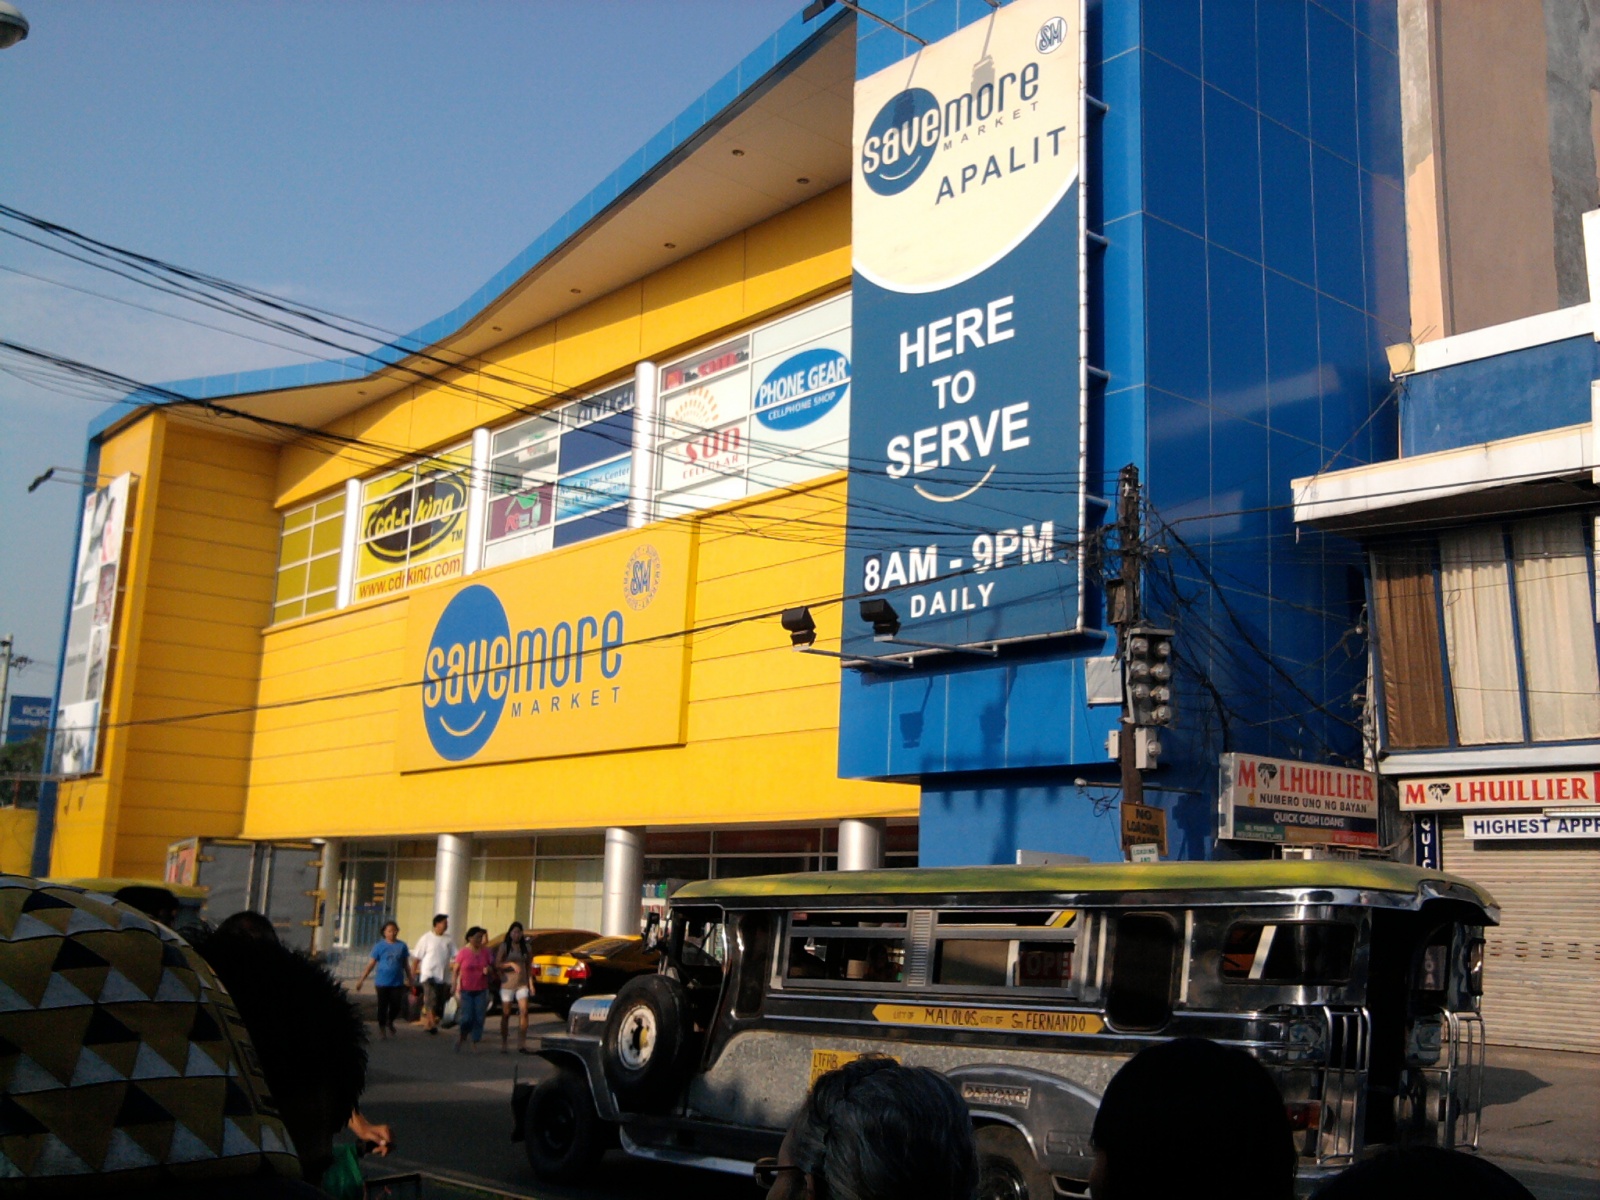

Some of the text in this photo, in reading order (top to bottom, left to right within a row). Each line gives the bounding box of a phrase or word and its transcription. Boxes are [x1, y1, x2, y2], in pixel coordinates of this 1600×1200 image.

[1038, 18, 1063, 53] SM
[862, 62, 1040, 174] savemore
[943, 101, 1039, 152] MARKET
[934, 126, 1067, 206] APALIT
[899, 295, 1015, 374] HERE
[759, 369, 805, 407] PHONE
[807, 356, 847, 390] GEAR
[931, 369, 976, 410] TO
[767, 391, 836, 421] CELLPHONE SHOP
[885, 401, 1030, 479] SERVE
[863, 543, 938, 592] 8AM
[971, 520, 1055, 575] 9PM
[910, 581, 996, 619] DAILY
[424, 610, 624, 708] savemore
[510, 686, 622, 718] MARKET
[1279, 765, 1375, 801] LHUILLIER
[1455, 777, 1590, 803] LHUILLIER
[1135, 808, 1152, 821] NO
[1259, 793, 1367, 814] NUMERO UNO NG BAYAN
[1273, 811, 1345, 828] QUICK CASH LOANS
[1473, 818, 1550, 835] HIGHEST
[1025, 1014, 1087, 1032] FERNANDO
